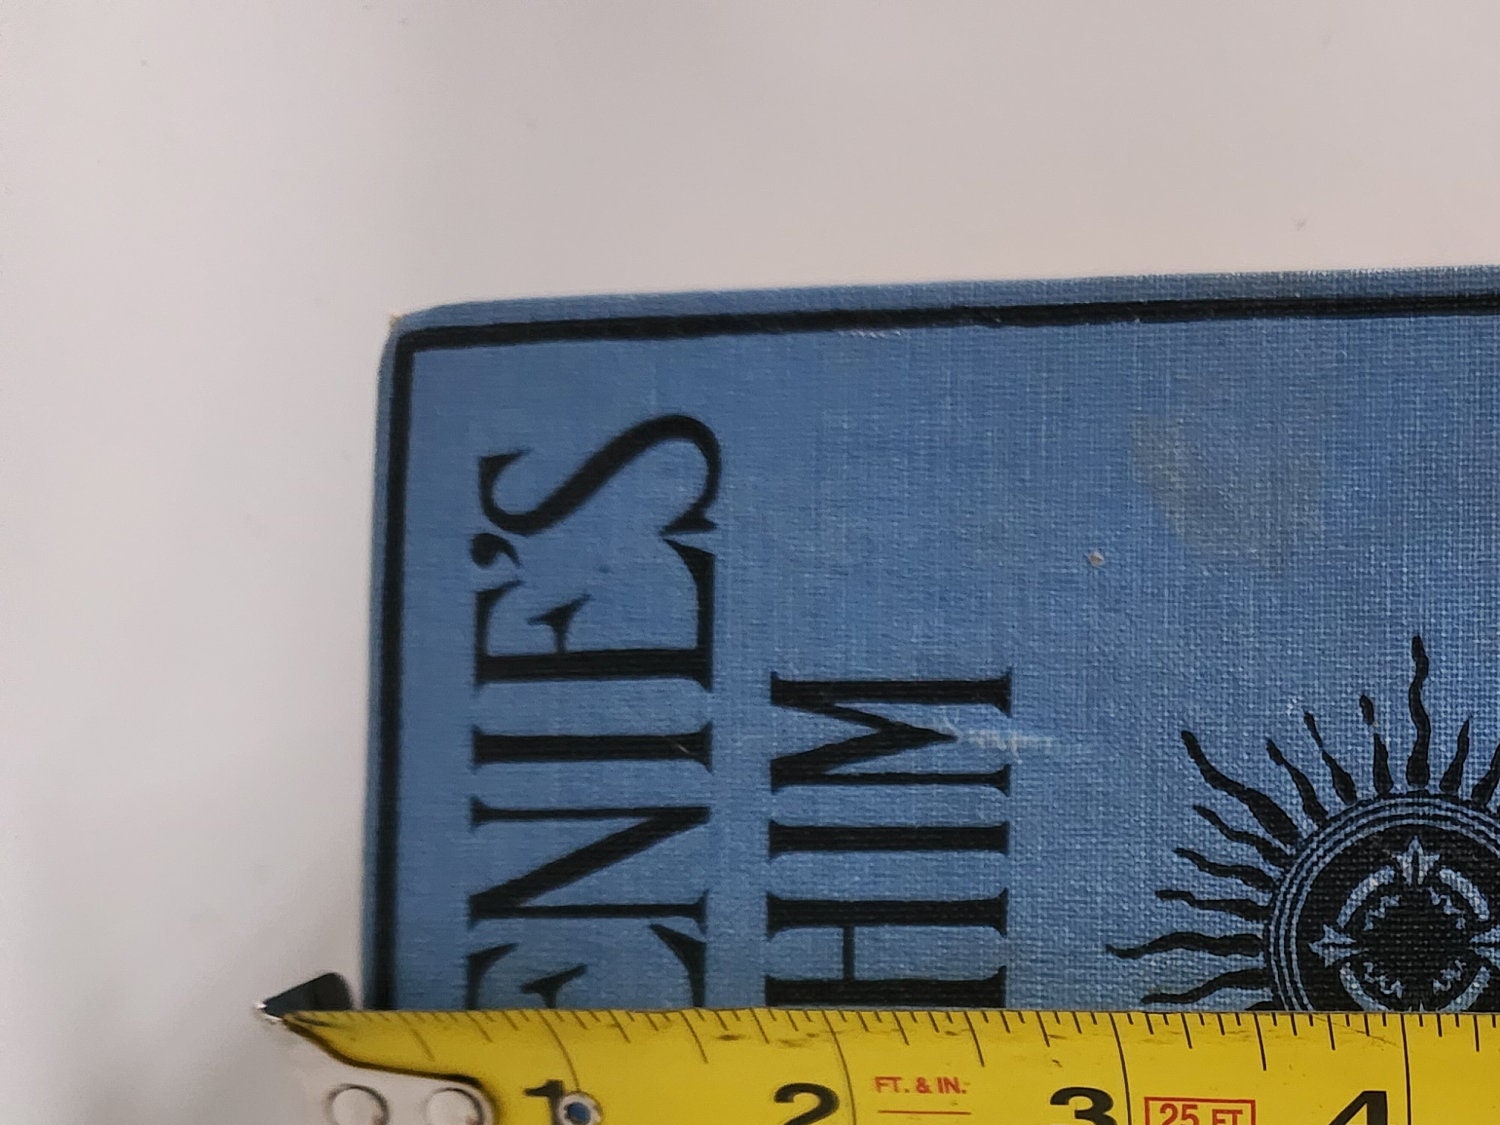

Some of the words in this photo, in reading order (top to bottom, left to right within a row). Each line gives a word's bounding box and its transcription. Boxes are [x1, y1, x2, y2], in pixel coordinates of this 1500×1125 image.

[874, 1076, 910, 1093] FT.
[916, 1076, 933, 1094] &
[937, 1076, 967, 1094] IN.
